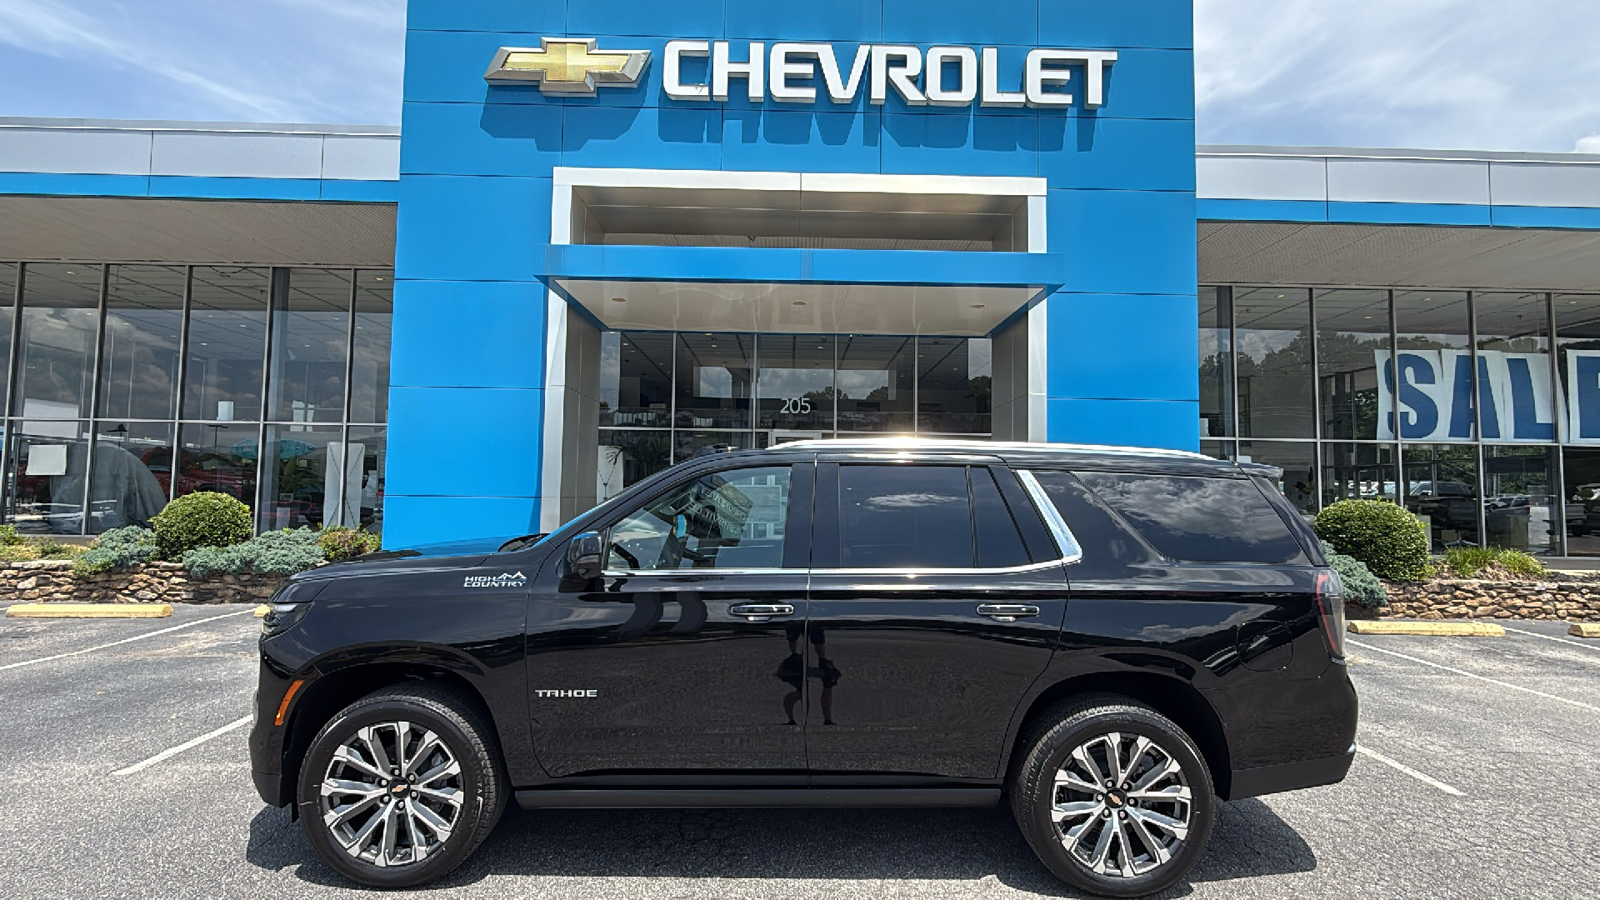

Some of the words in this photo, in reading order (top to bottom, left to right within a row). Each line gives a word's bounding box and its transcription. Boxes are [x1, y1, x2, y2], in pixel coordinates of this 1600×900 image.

[663, 40, 1118, 109] CHEVROLET
[780, 397, 811, 414] 205
[535, 689, 598, 697] TAHOE
